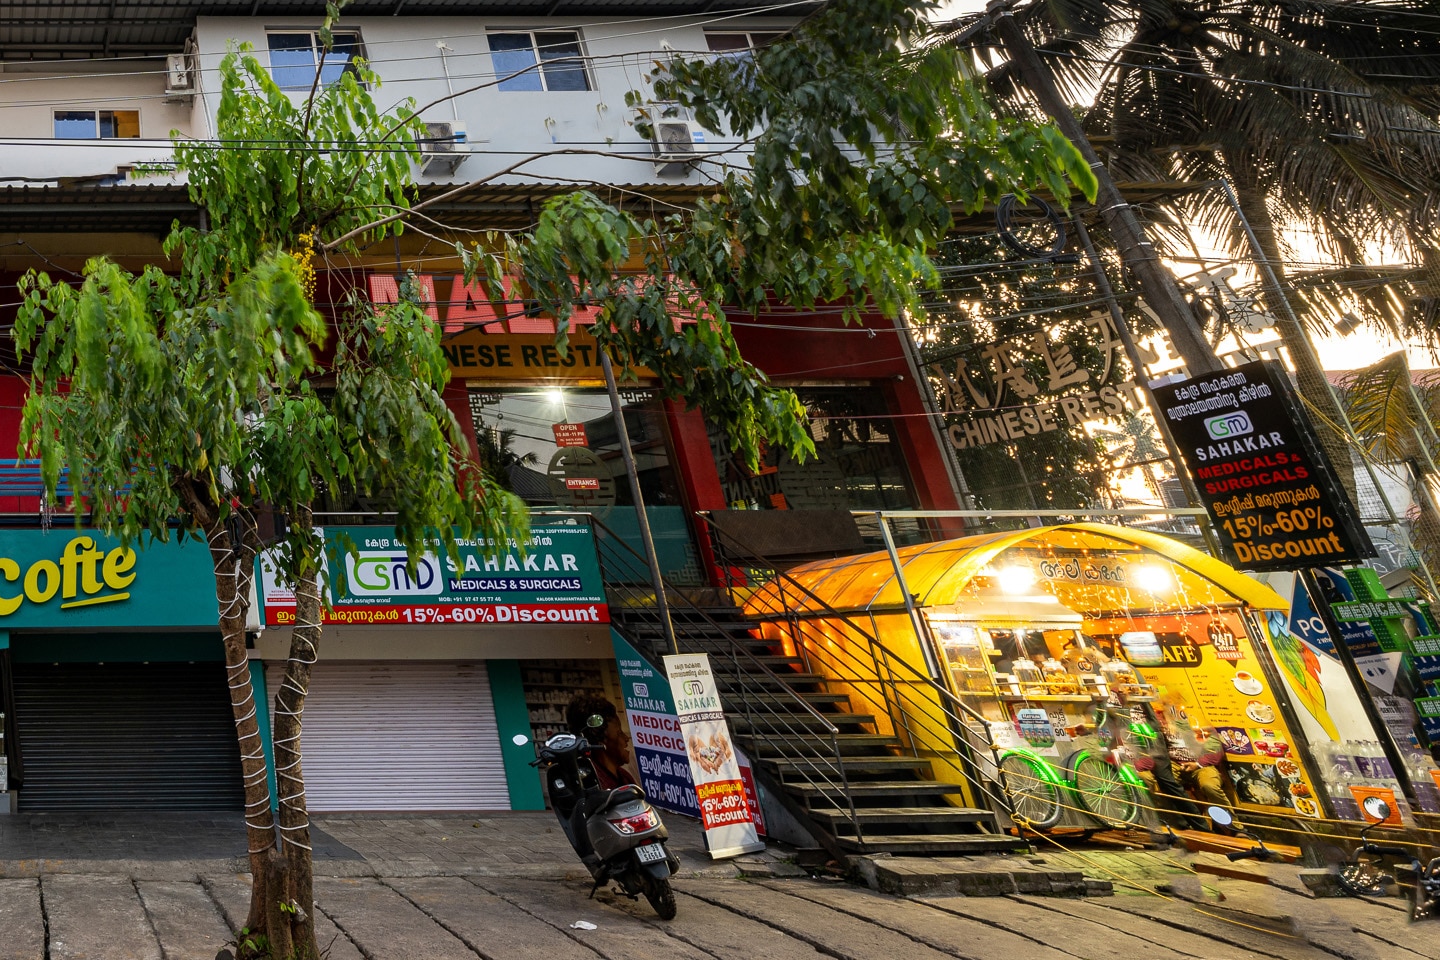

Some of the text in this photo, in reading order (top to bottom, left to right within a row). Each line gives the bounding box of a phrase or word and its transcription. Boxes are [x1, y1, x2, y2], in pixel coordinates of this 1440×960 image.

[948, 403, 1058, 449] CHINESE
[1195, 431, 1285, 461] SAHAKAR
[1197, 452, 1301, 479] MEDICALS &
[1205, 466, 1309, 495] SURGICALS
[1223, 506, 1334, 539] 15%-60%
[1233, 531, 1345, 563] Discount
[445, 554, 579, 572] SAHAKAR
[451, 580, 581, 590] MEDICALS & SURGICALS
[402, 606, 599, 622] 15%-60% Discount
[627, 697, 666, 712] SAHAKAR
[632, 715, 680, 732] MEDICA
[636, 731, 686, 751] SURGIC
[705, 808, 750, 826] Discount
